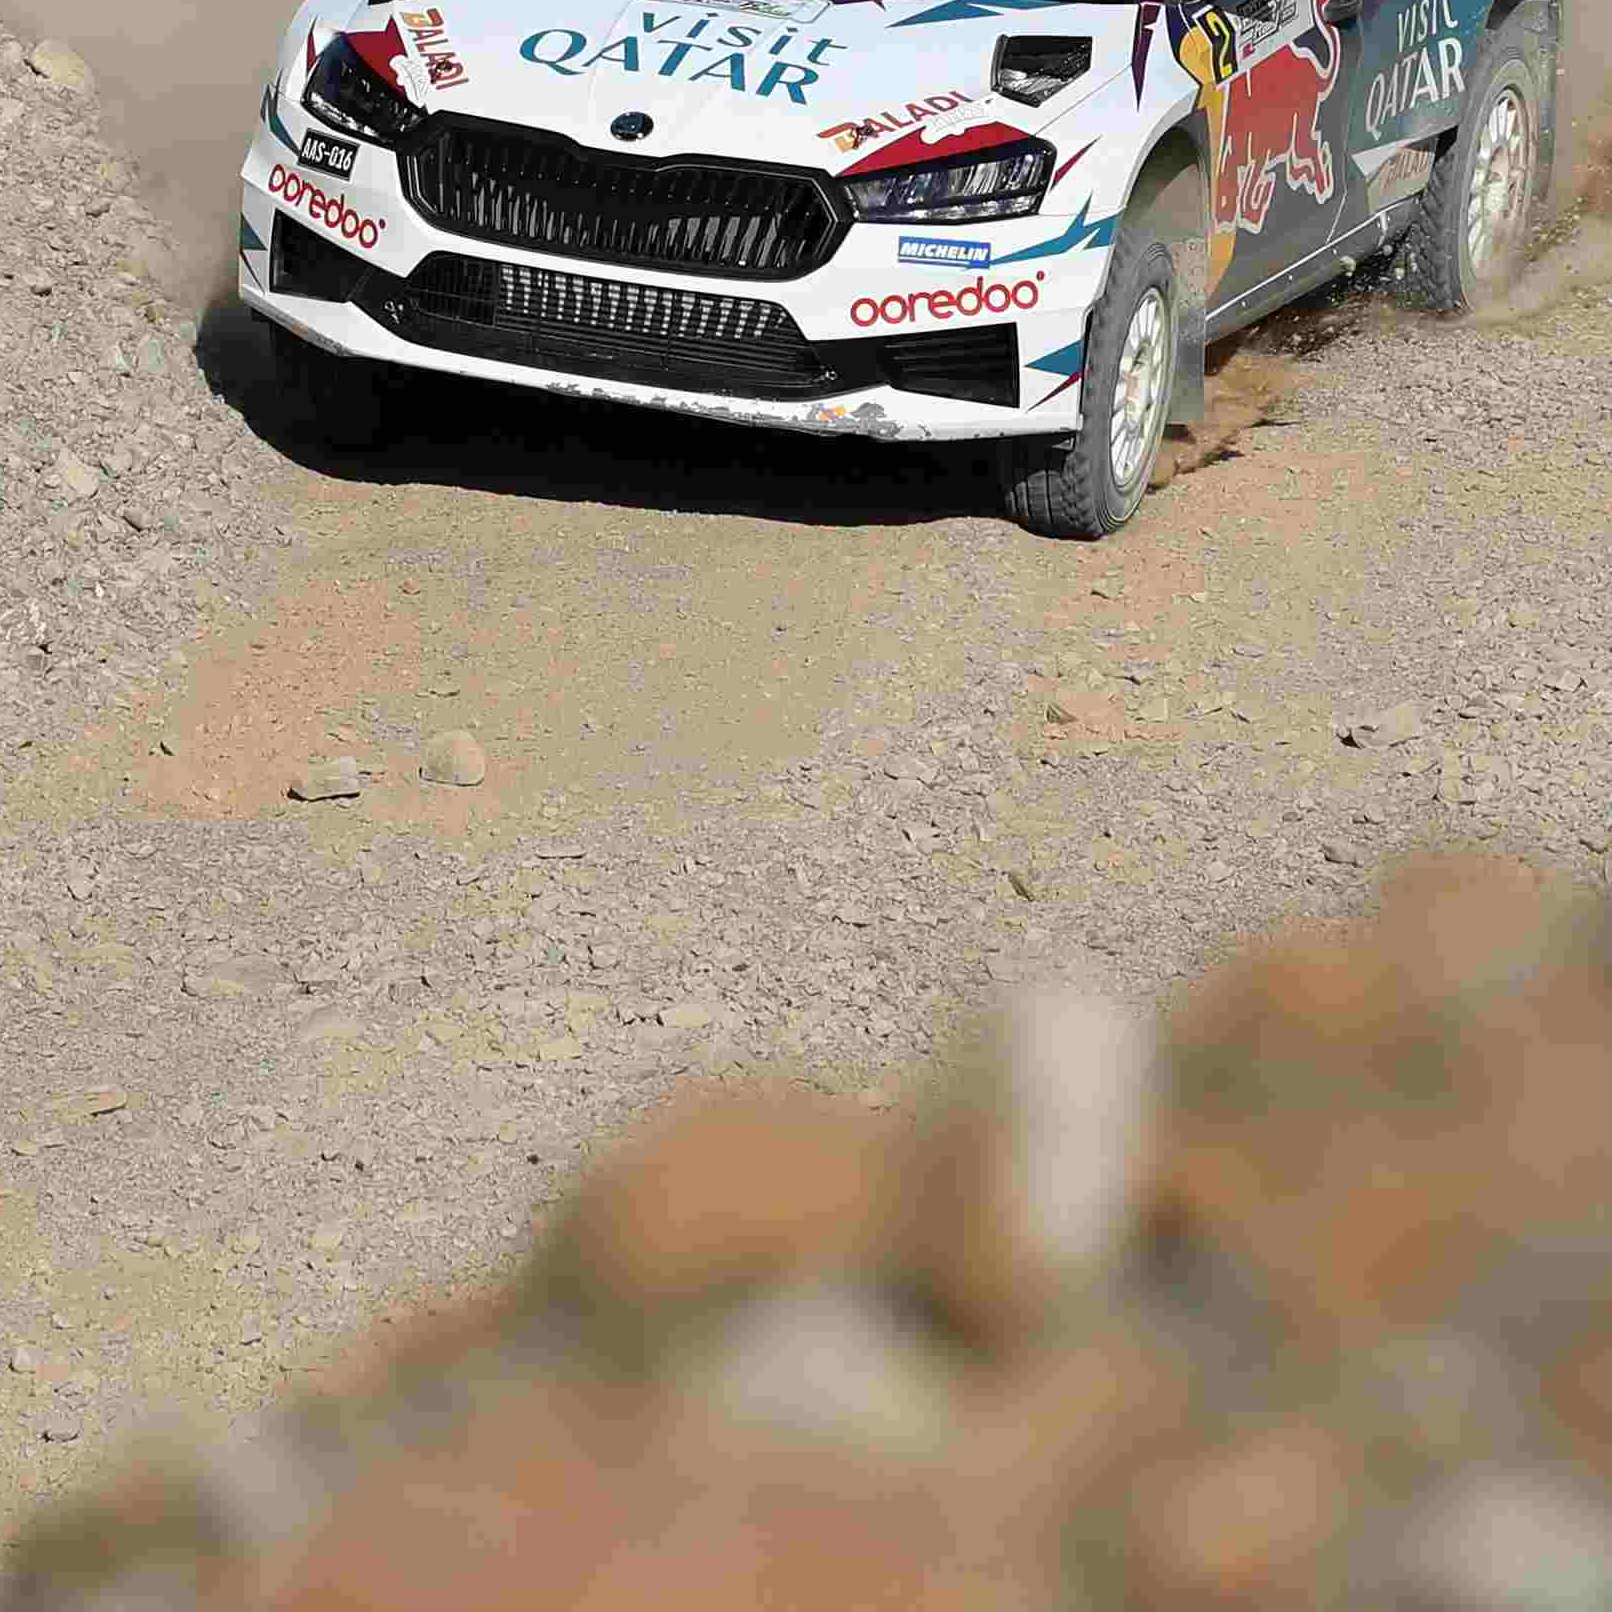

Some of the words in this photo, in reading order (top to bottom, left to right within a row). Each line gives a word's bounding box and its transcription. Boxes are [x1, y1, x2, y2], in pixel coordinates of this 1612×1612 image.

[519, 28, 819, 106] QATAR
[641, 12, 847, 67] visit
[1205, 10, 1234, 79] 2
[1365, 37, 1465, 140] QATAR
[301, 138, 354, 172] AAS-016
[268, 163, 386, 249] ooredoo
[899, 241, 991, 261] MICHELIN
[850, 270, 1045, 327] ooredoo
